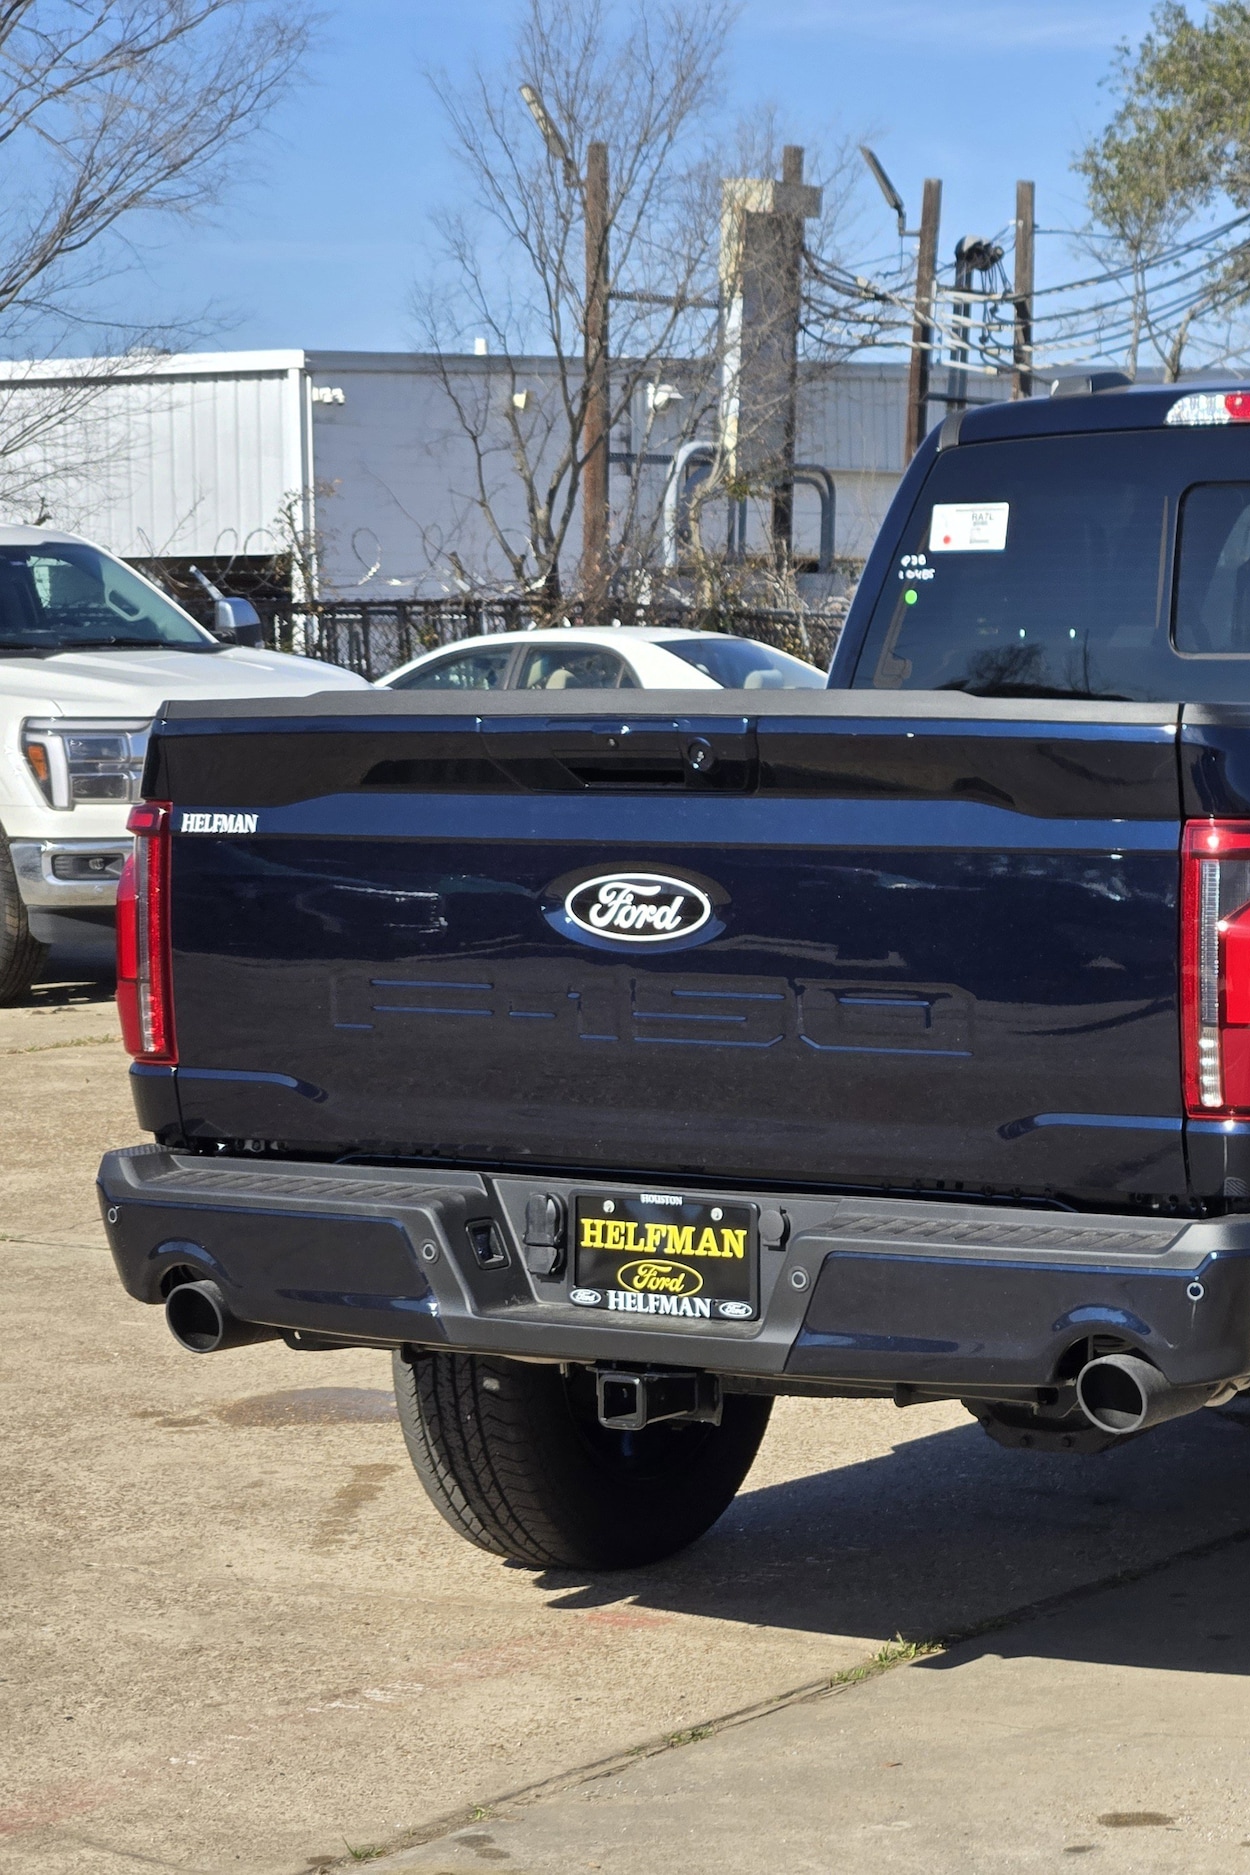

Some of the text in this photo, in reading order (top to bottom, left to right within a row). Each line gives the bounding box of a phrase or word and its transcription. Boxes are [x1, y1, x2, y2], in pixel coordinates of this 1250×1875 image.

[181, 813, 259, 833] HELFMAN
[589, 881, 683, 932] Ford
[332, 972, 976, 1058] F-150
[640, 1194, 683, 1206] HOUSTON
[580, 1218, 747, 1258] HELFMAN
[632, 1262, 686, 1293] Ford
[607, 1290, 712, 1318] HELFMAN
